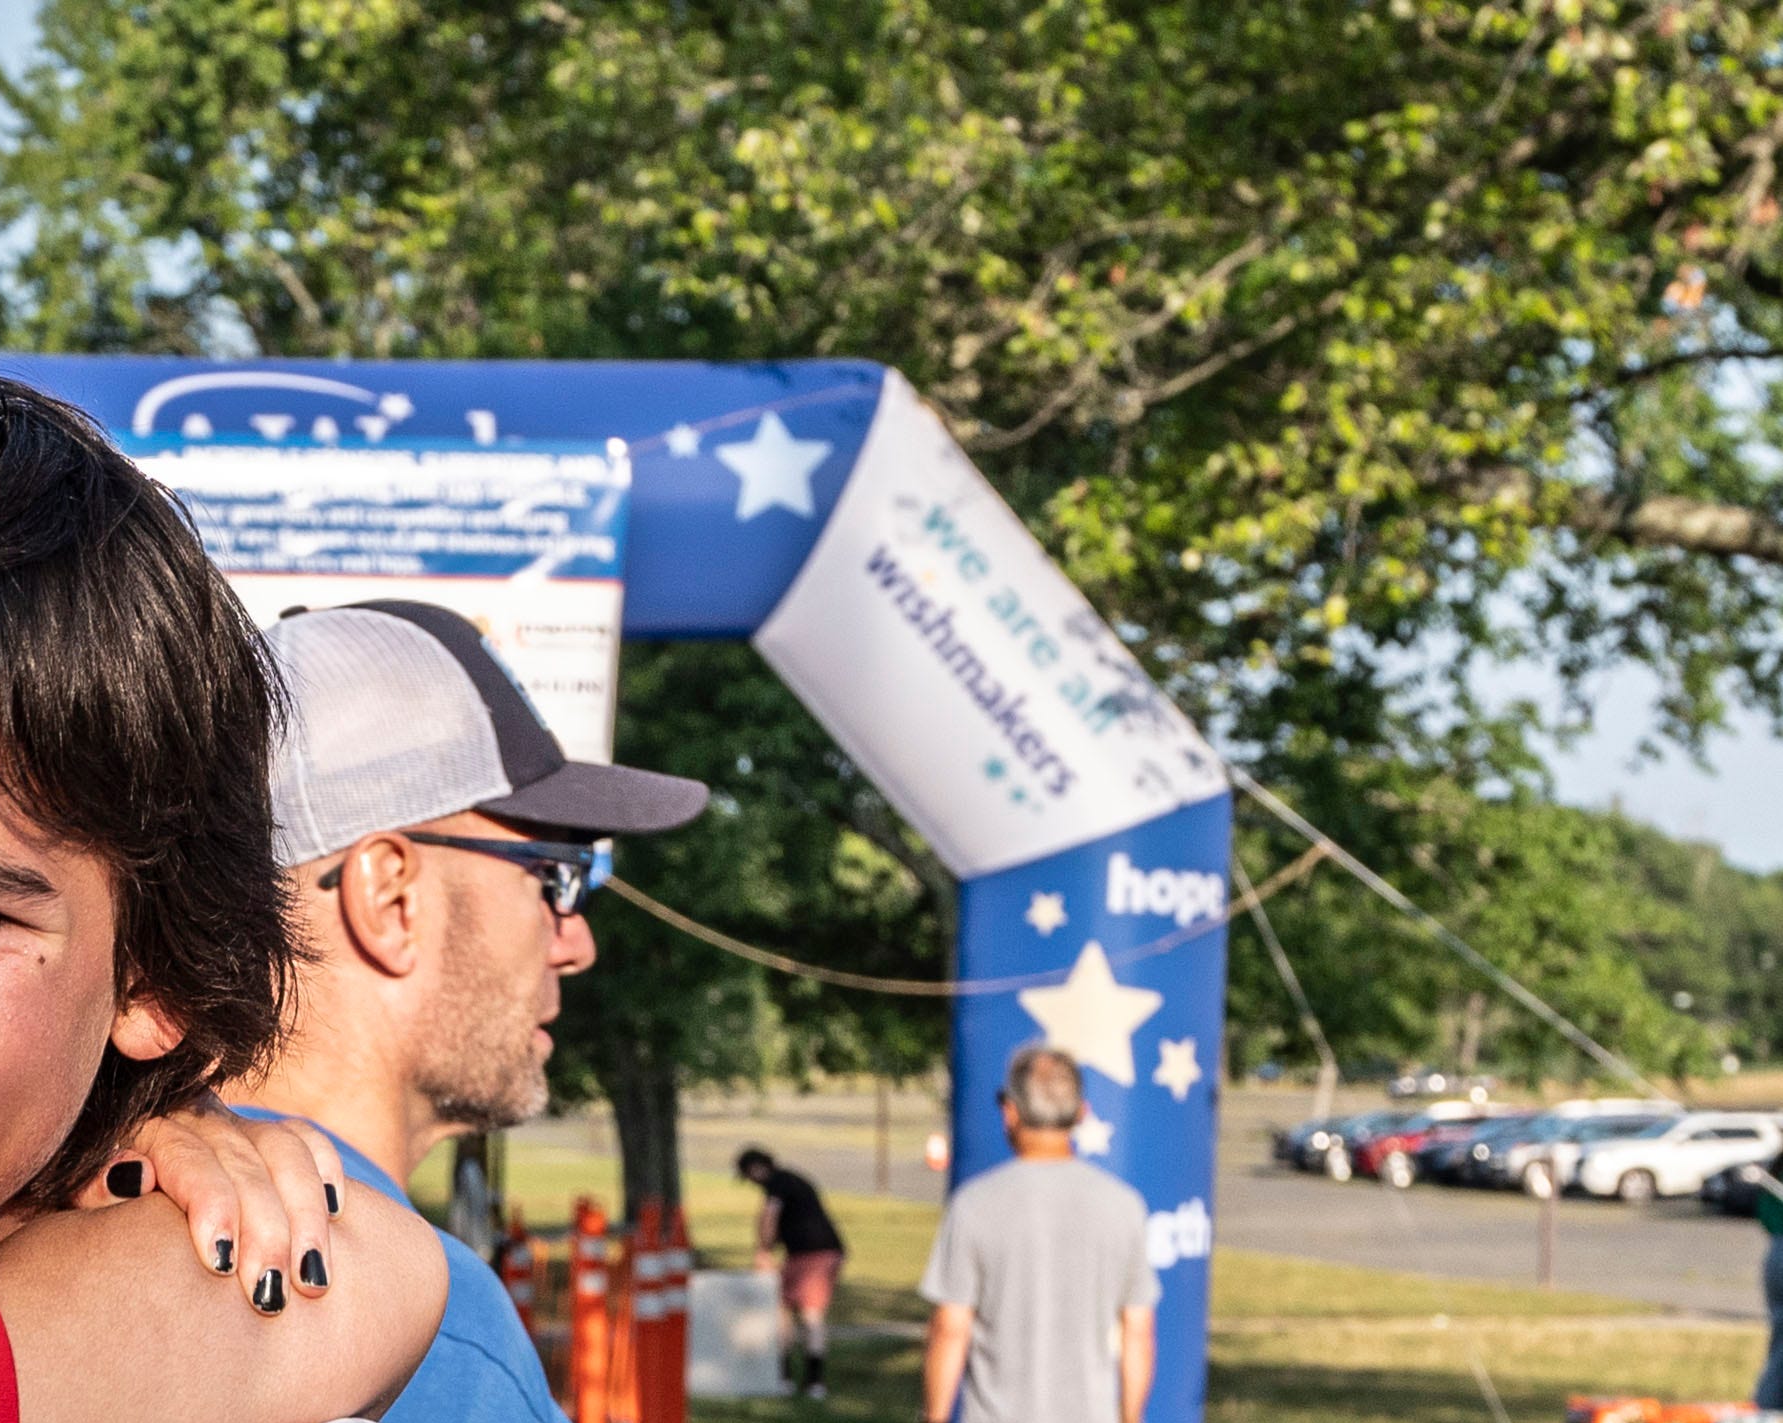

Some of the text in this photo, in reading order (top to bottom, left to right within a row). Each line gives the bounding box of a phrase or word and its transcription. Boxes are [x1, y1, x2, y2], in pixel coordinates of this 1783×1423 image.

[865, 542, 1077, 797] wishmakers
[922, 505, 989, 581] we
[985, 587, 1061, 669] are
